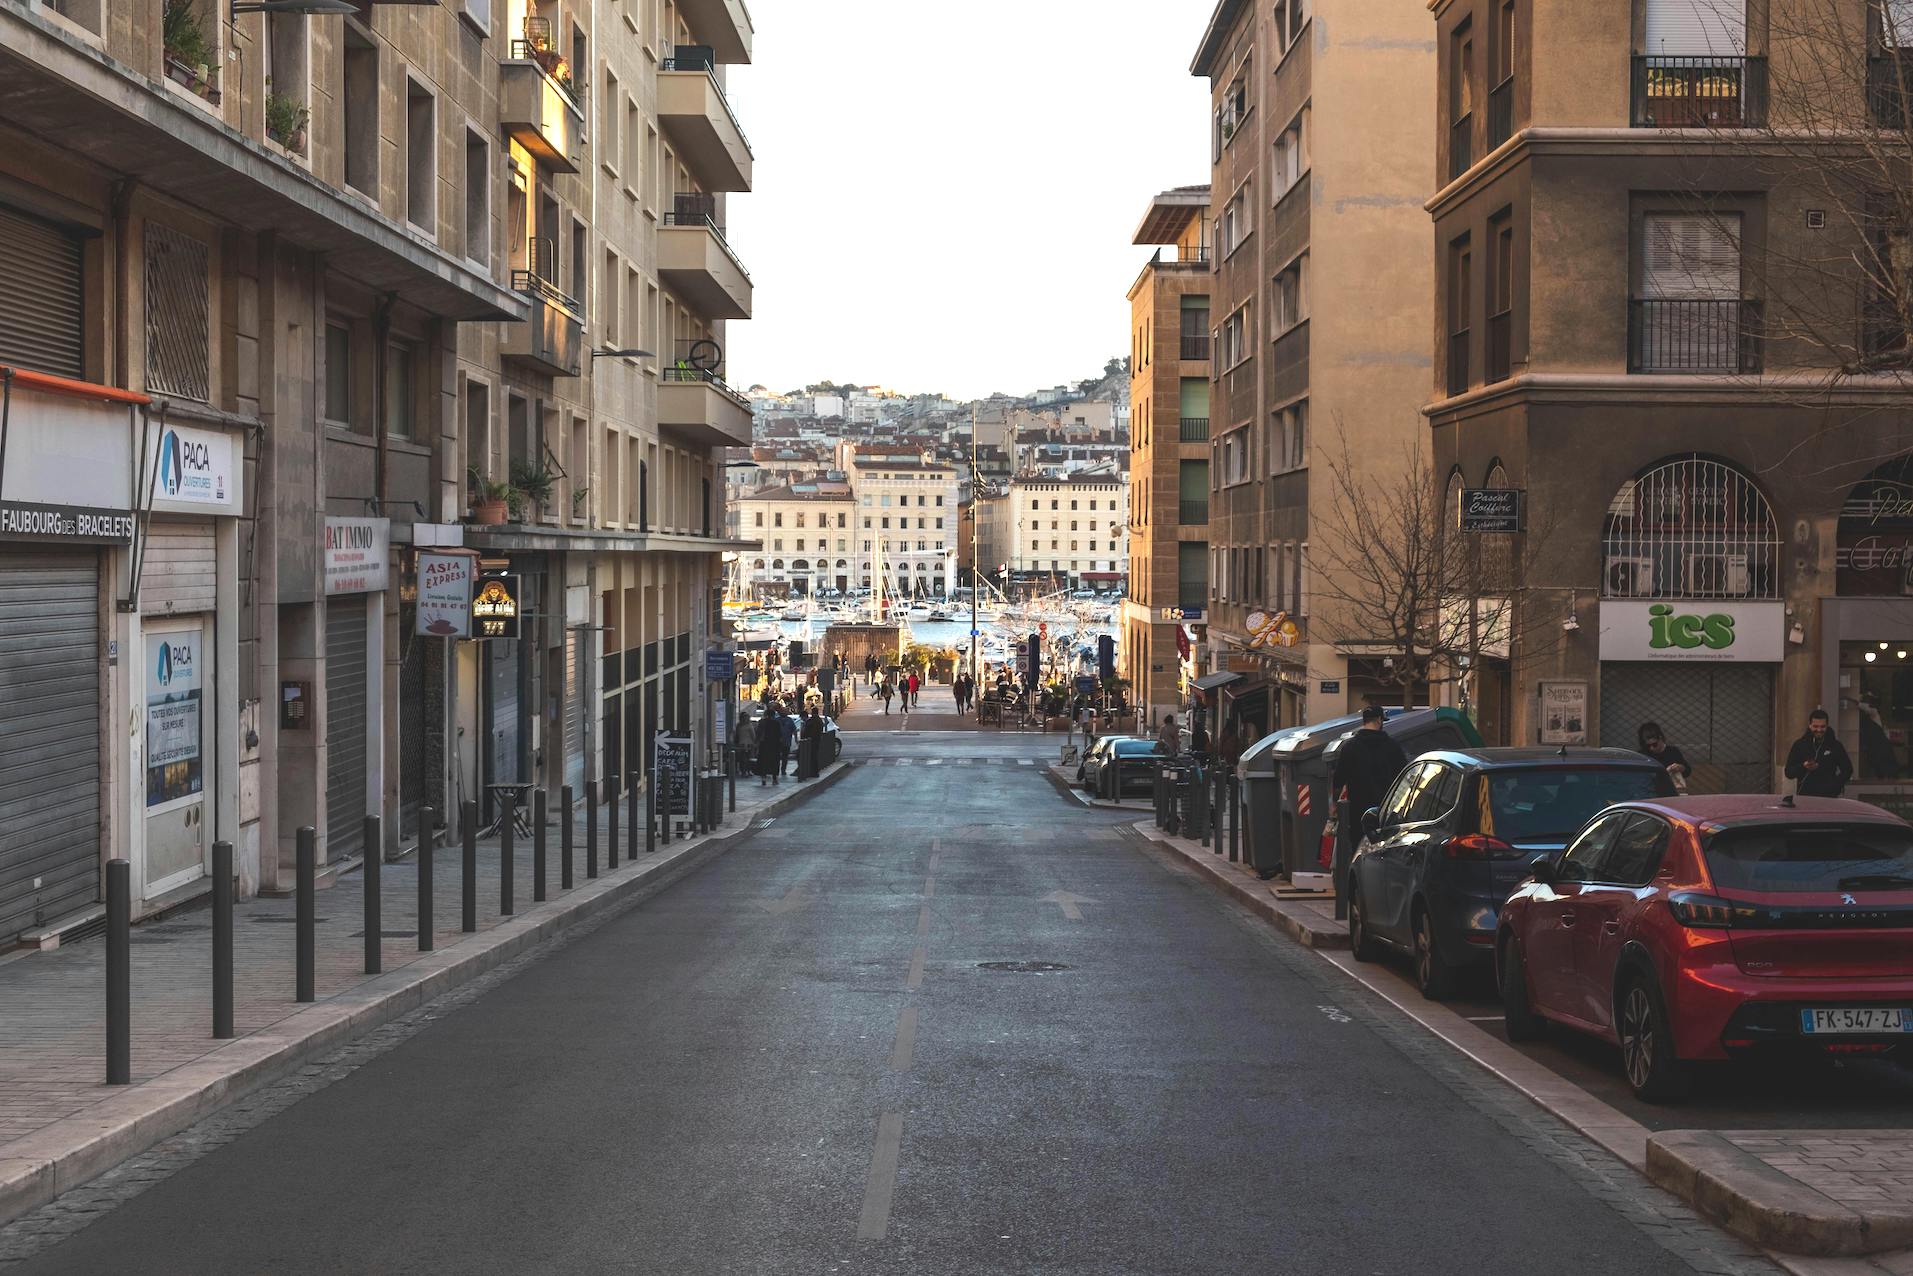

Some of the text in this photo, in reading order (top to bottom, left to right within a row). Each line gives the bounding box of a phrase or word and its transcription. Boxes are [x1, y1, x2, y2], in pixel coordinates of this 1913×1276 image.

[183, 441, 210, 471] PACA
[1470, 501, 1511, 513] Coiffure
[1472, 491, 1509, 503] Pascal
[2, 509, 61, 534] FAUBOURG
[78, 514, 132, 537] BRACELETS
[326, 526, 373, 549] BAT IMMO
[426, 562, 460, 574] ASIA
[426, 571, 466, 589] EXPRESS
[1648, 604, 1735, 649] ics
[173, 646, 192, 666] PACA
